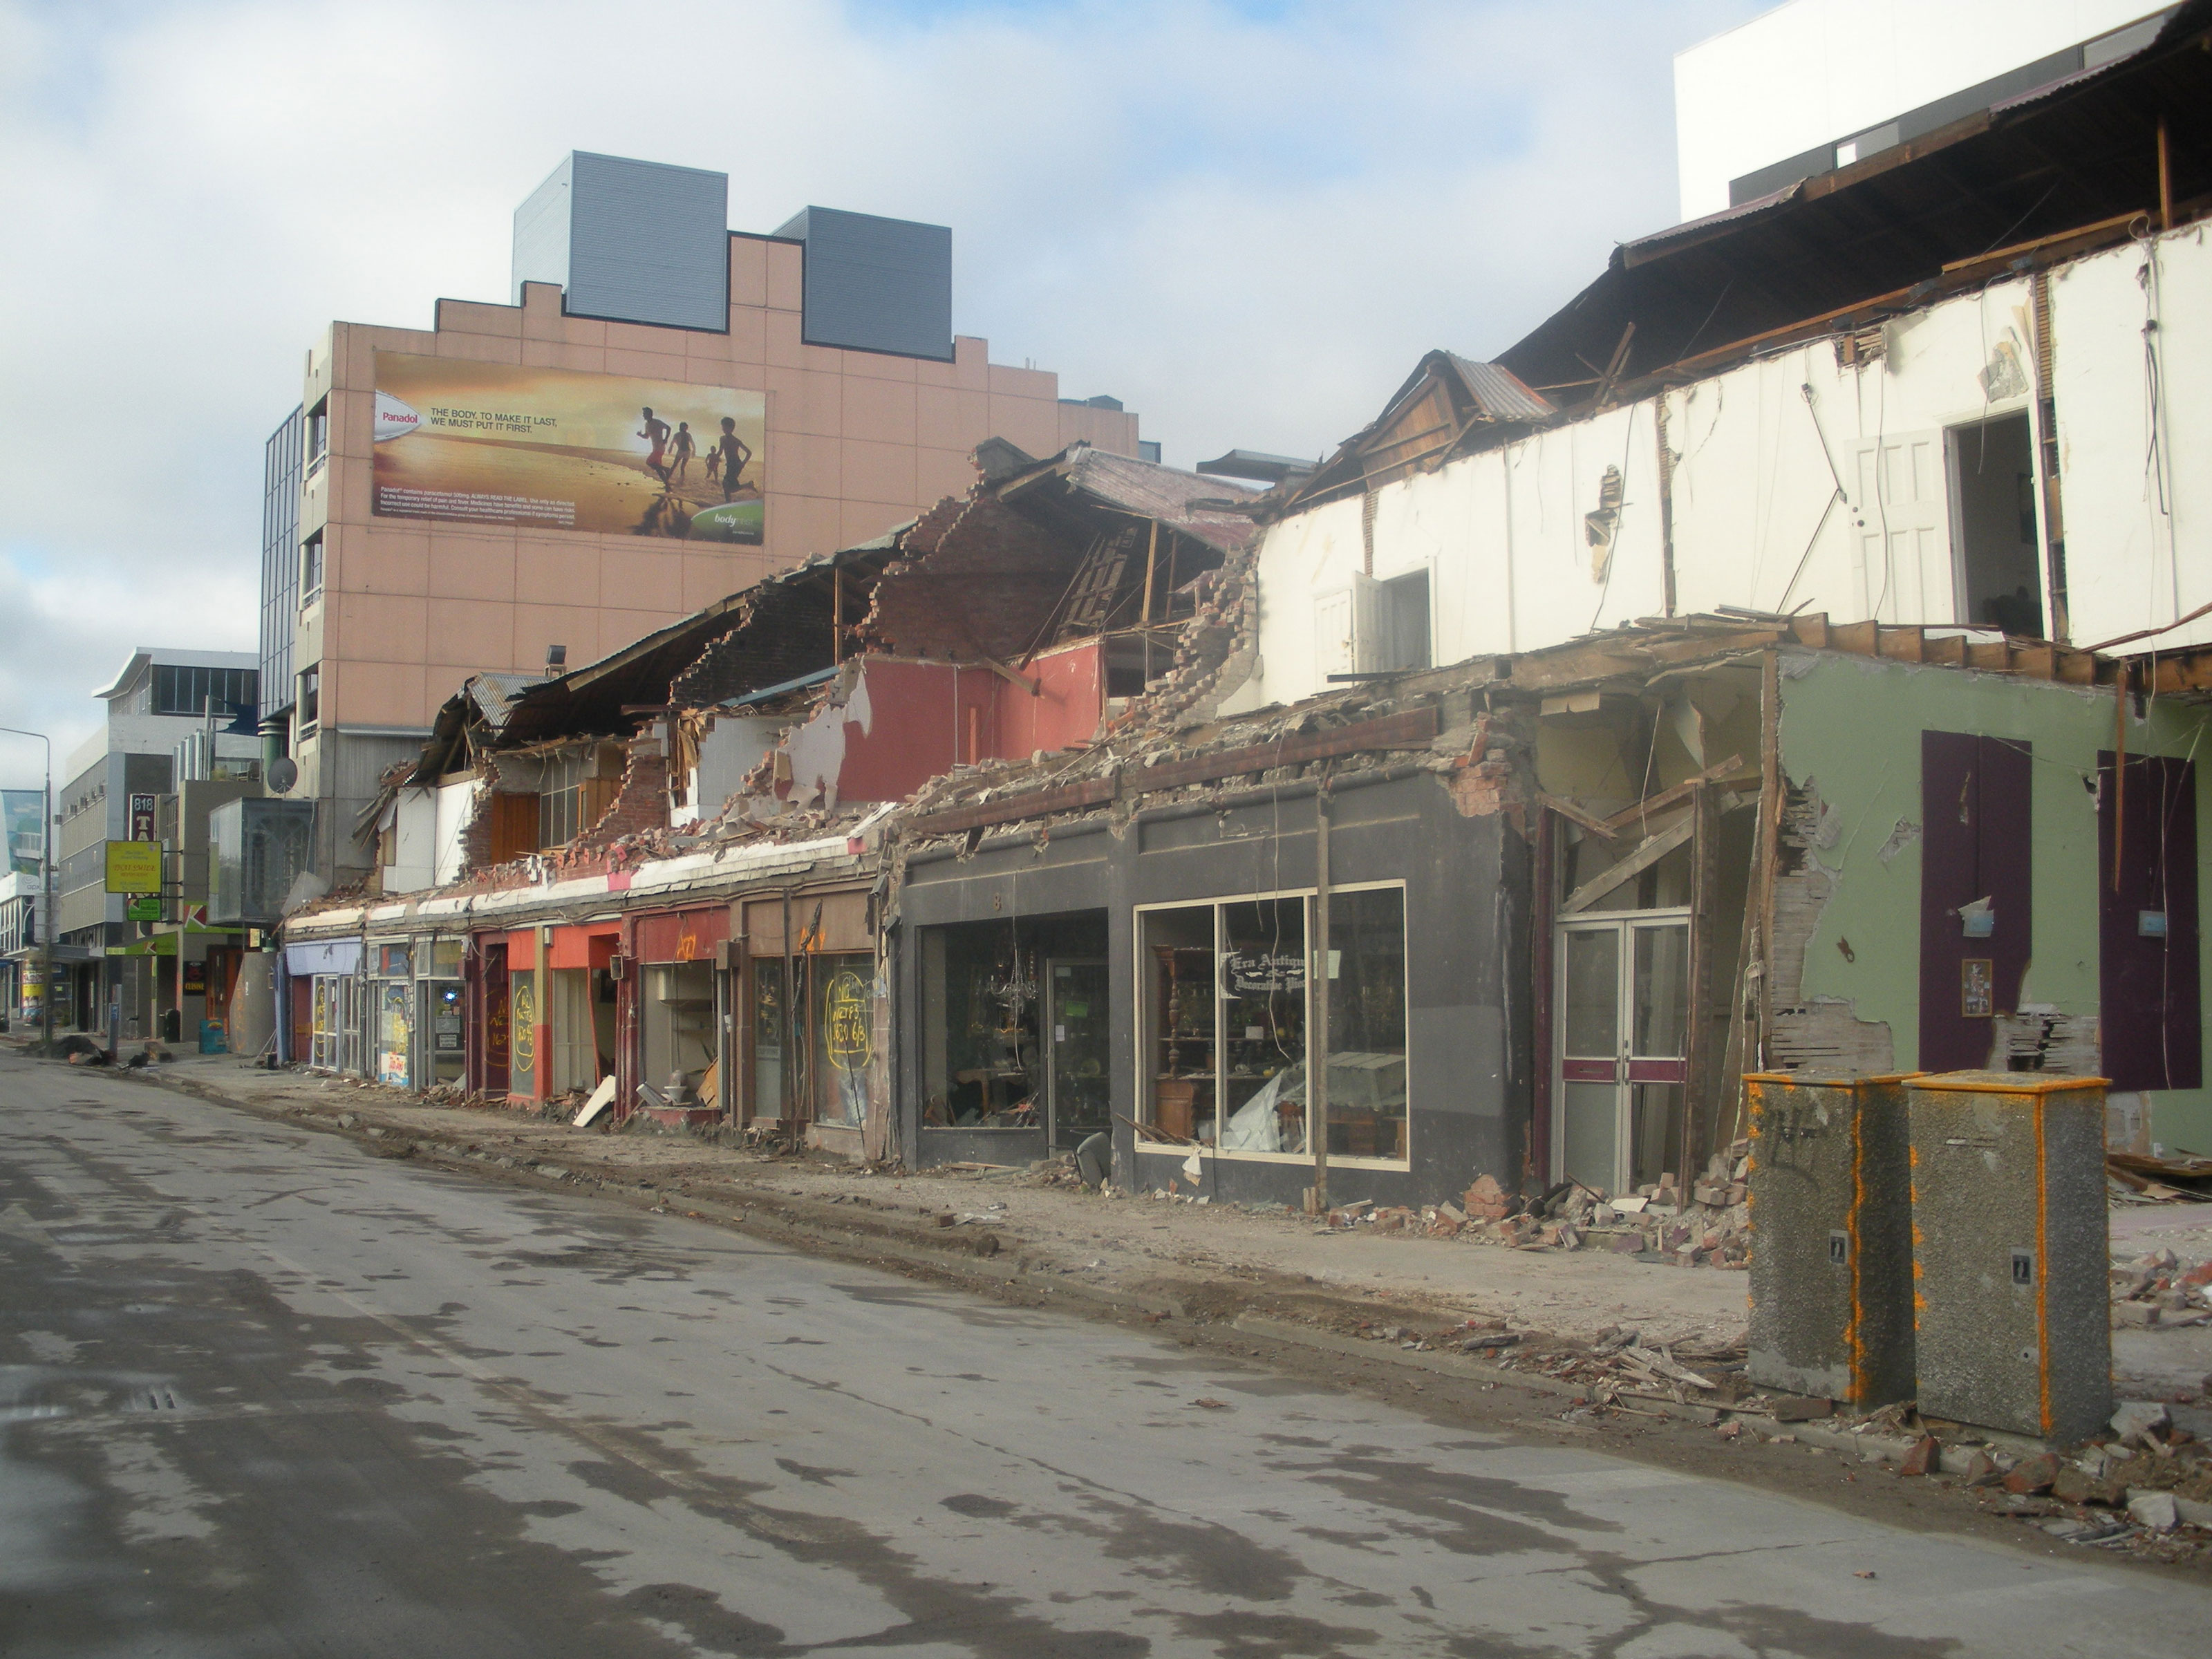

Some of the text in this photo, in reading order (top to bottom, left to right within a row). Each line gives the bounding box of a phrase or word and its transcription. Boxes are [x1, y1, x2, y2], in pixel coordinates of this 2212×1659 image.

[382, 412, 418, 423] Panadol
[431, 408, 449, 417] THE
[451, 410, 478, 420] BODY.
[480, 412, 492, 420] TO
[495, 413, 521, 423] MAKE
[534, 417, 557, 427] LAST,
[431, 417, 532, 433] WE MUST PUT IT FIRST.
[134, 798, 153, 811] 818
